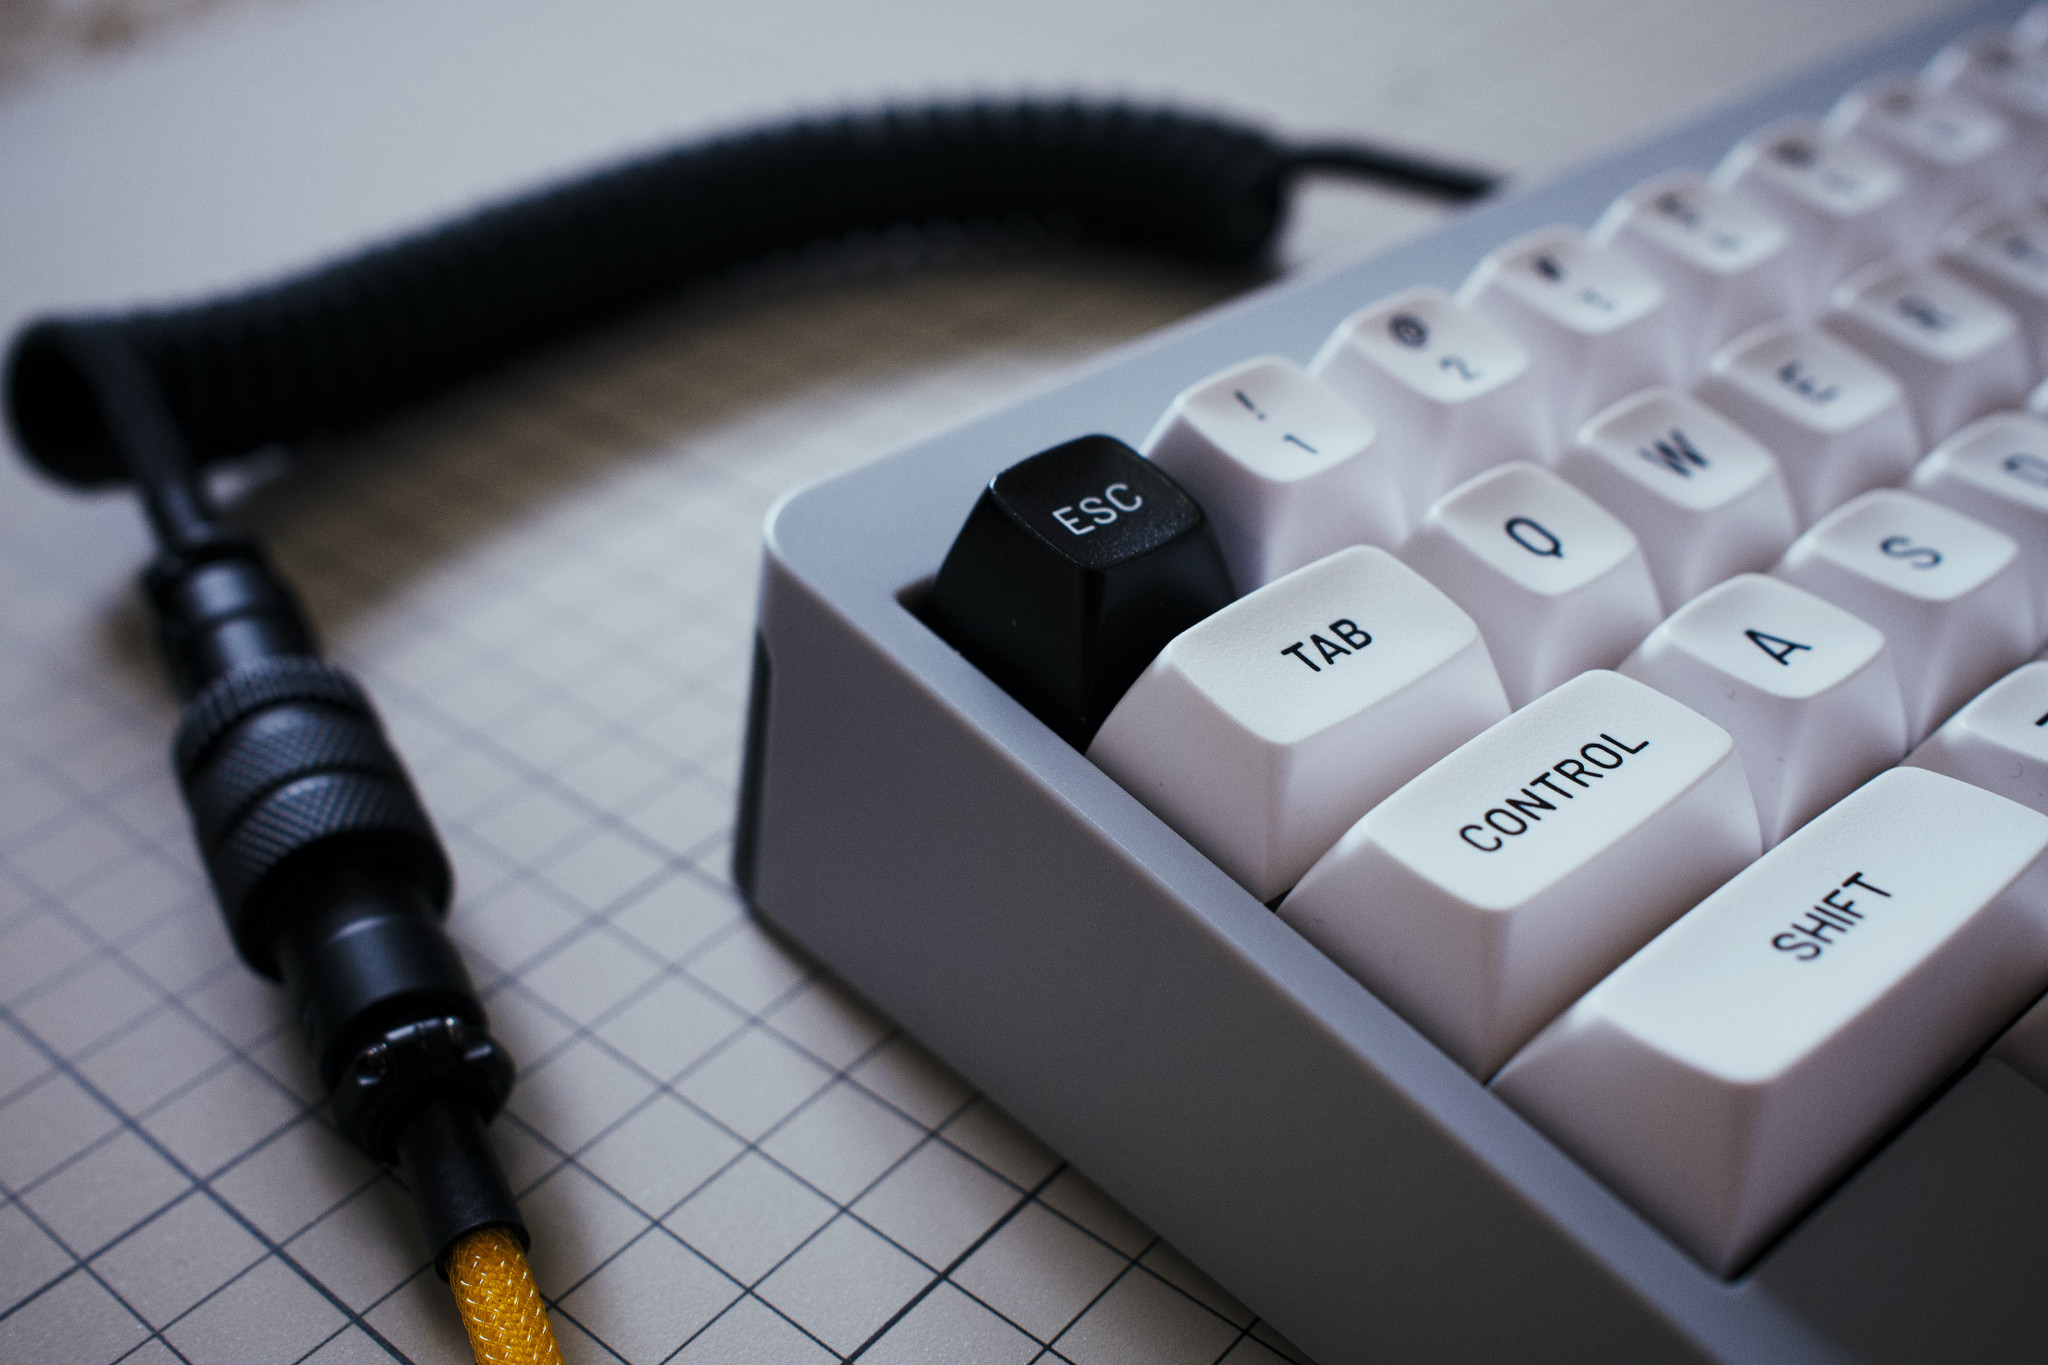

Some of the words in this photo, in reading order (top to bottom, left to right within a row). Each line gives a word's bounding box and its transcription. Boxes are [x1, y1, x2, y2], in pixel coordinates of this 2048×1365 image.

[1438, 355, 1483, 381] 2
[1282, 433, 1318, 454] 1
[1638, 429, 1709, 478] W
[1051, 483, 1143, 536] ESC
[1503, 516, 1565, 559] Q
[1878, 535, 1943, 569] S
[1280, 618, 1373, 673] TAB
[1743, 628, 1812, 667] A
[1458, 732, 1650, 853] CONTROL
[1771, 871, 1892, 962] SHIFT
